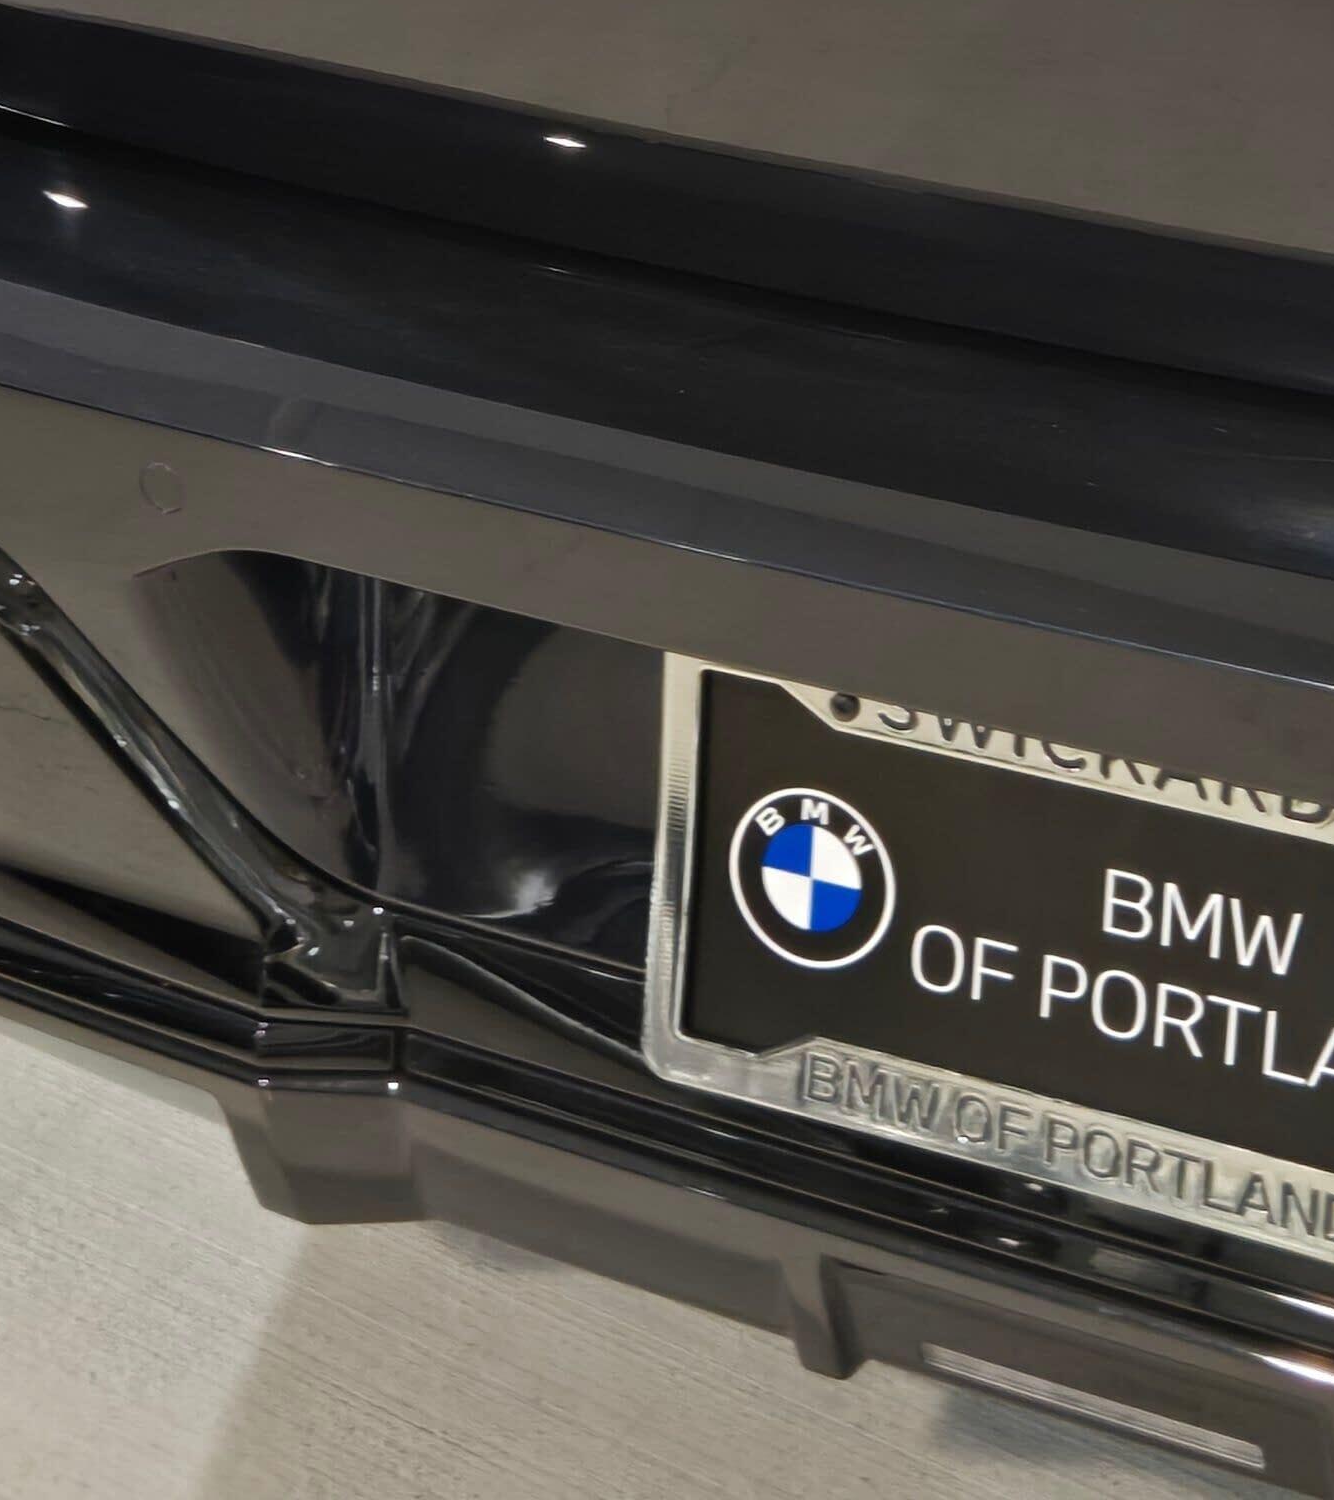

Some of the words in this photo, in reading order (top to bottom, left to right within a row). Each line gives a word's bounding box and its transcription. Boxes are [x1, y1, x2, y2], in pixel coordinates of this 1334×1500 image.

[754, 798, 875, 857] BMW
[910, 924, 1020, 1001] OF
[1102, 868, 1304, 976] BMW
[801, 1050, 940, 1134] BMW
[954, 1090, 1031, 1154] OF
